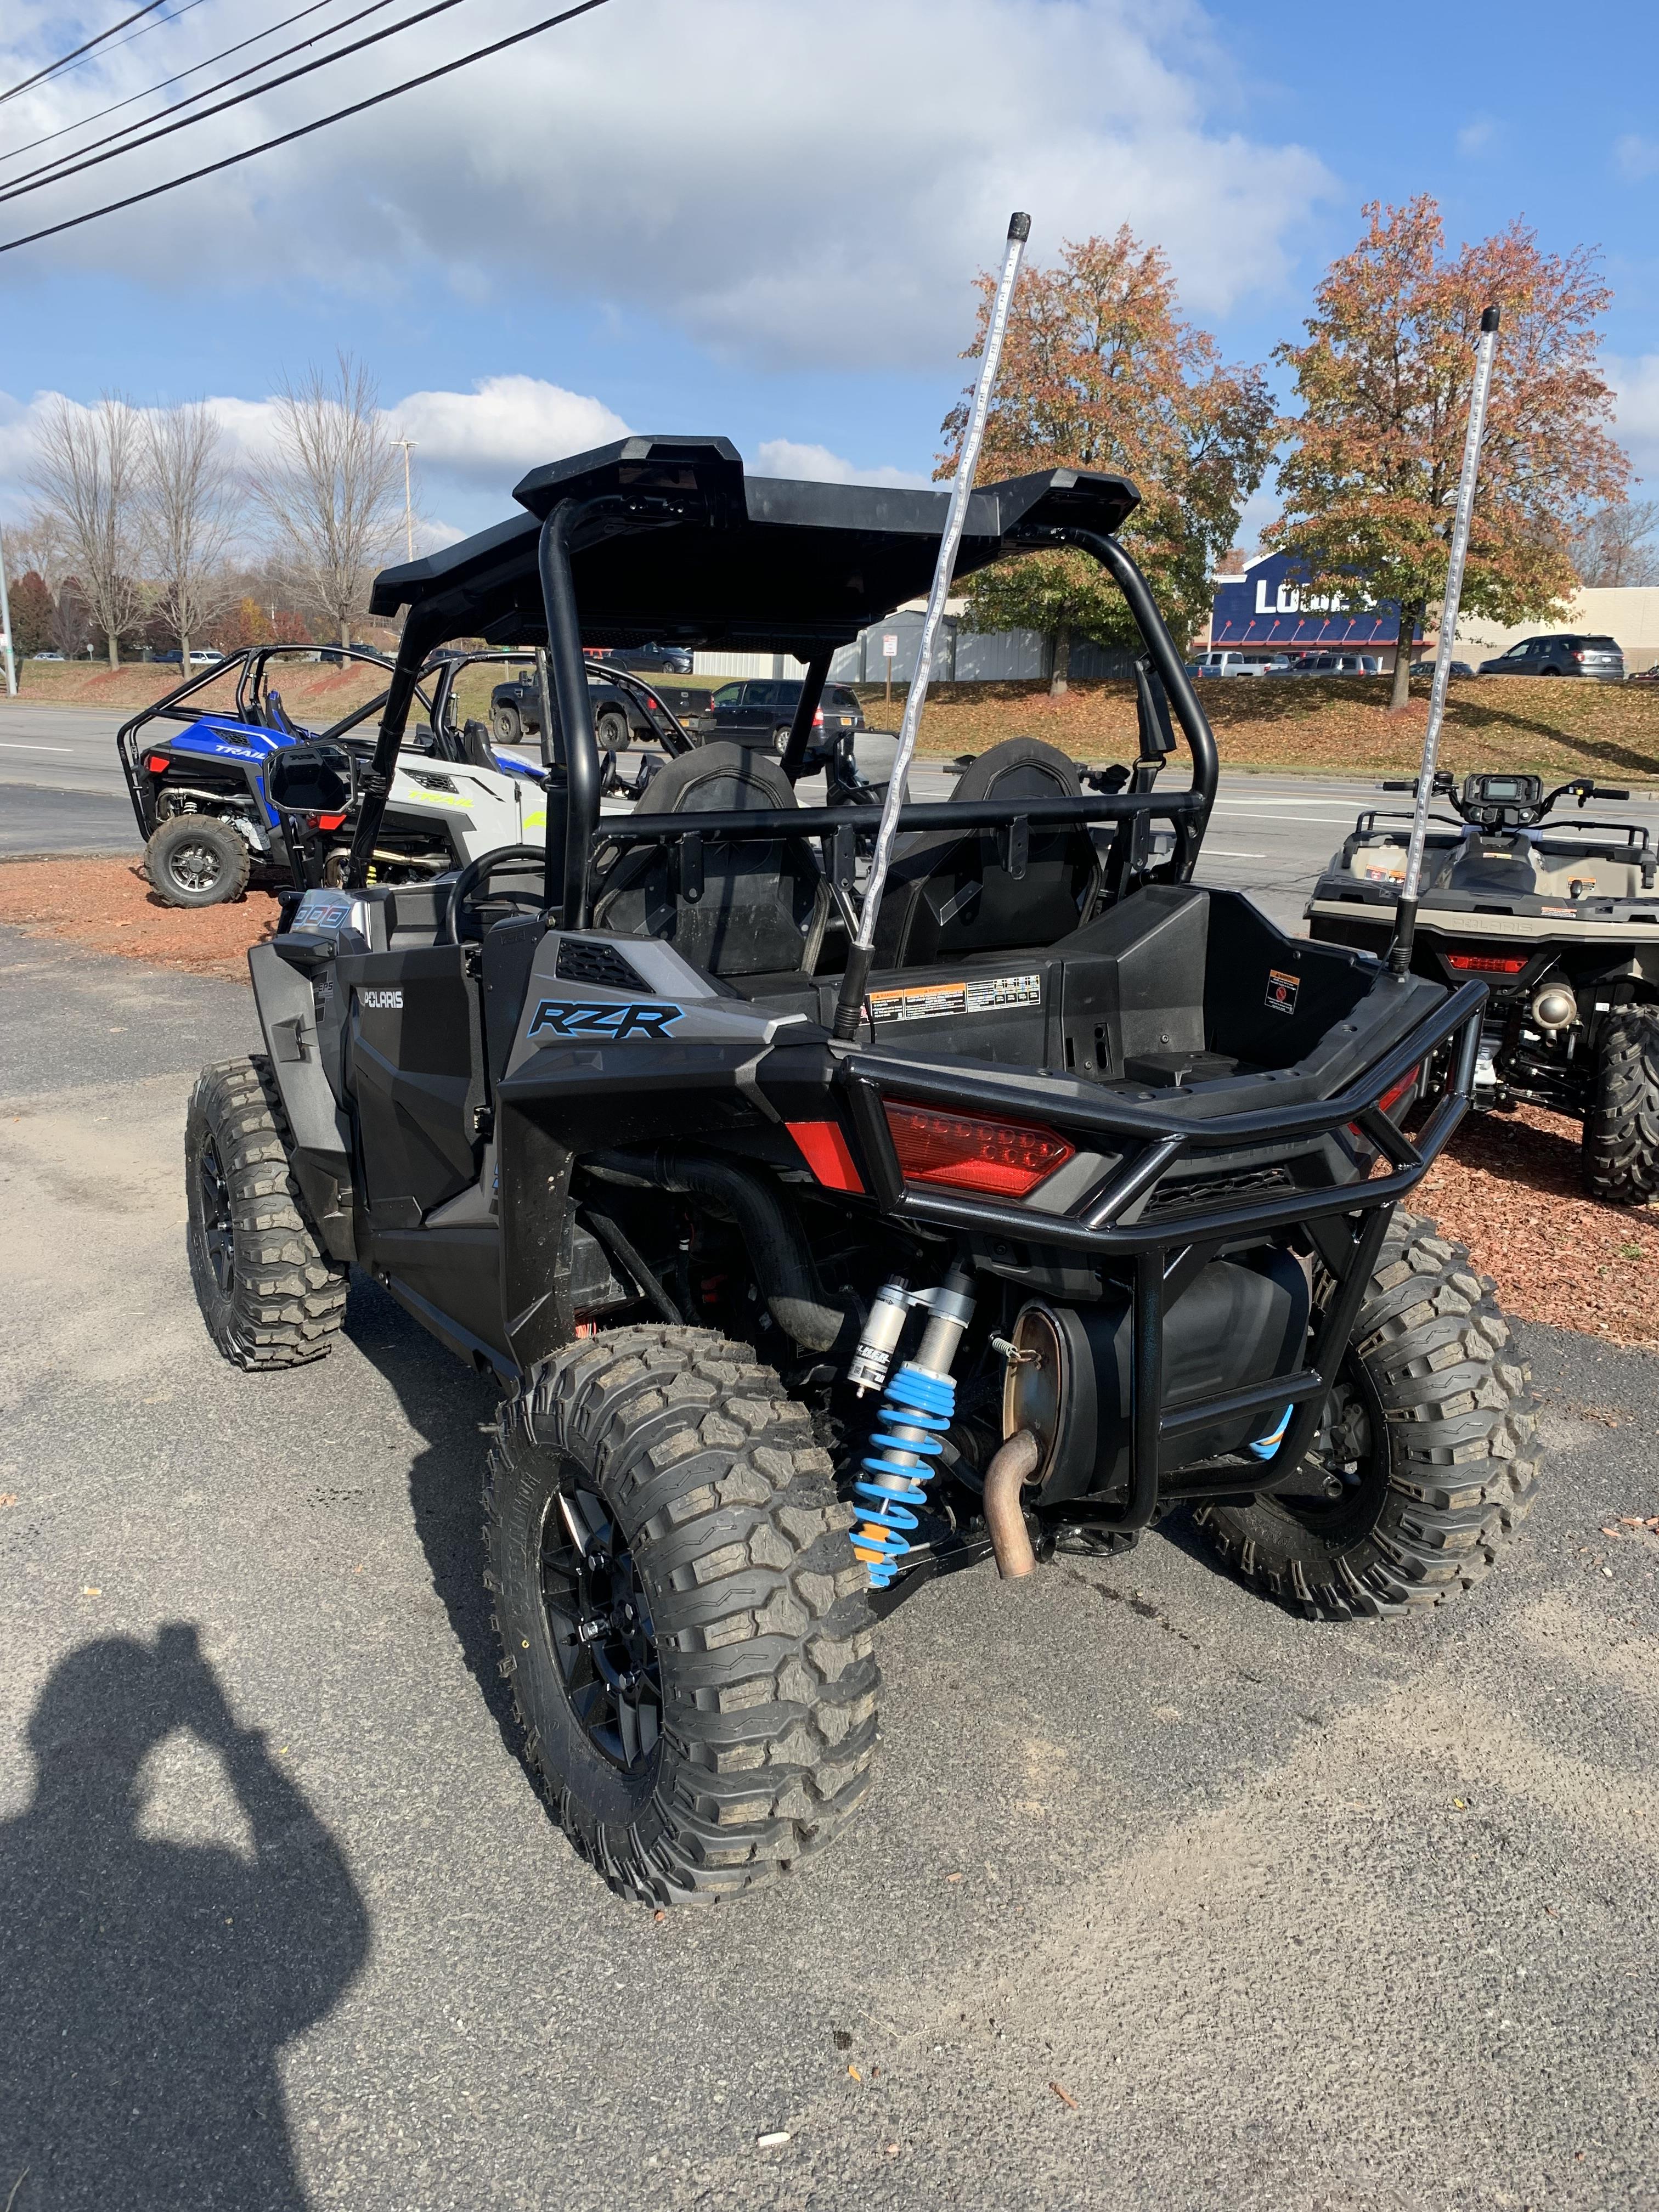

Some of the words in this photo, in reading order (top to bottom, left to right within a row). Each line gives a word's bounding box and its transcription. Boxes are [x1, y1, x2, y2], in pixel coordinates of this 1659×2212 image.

[216, 745, 266, 760] TRAIL
[408, 791, 475, 808] TRAIL
[1452, 918, 1532, 932] POLARIS
[318, 982, 334, 992] EPS
[364, 991, 404, 1008] POLARIS
[527, 998, 686, 1039] RZR
